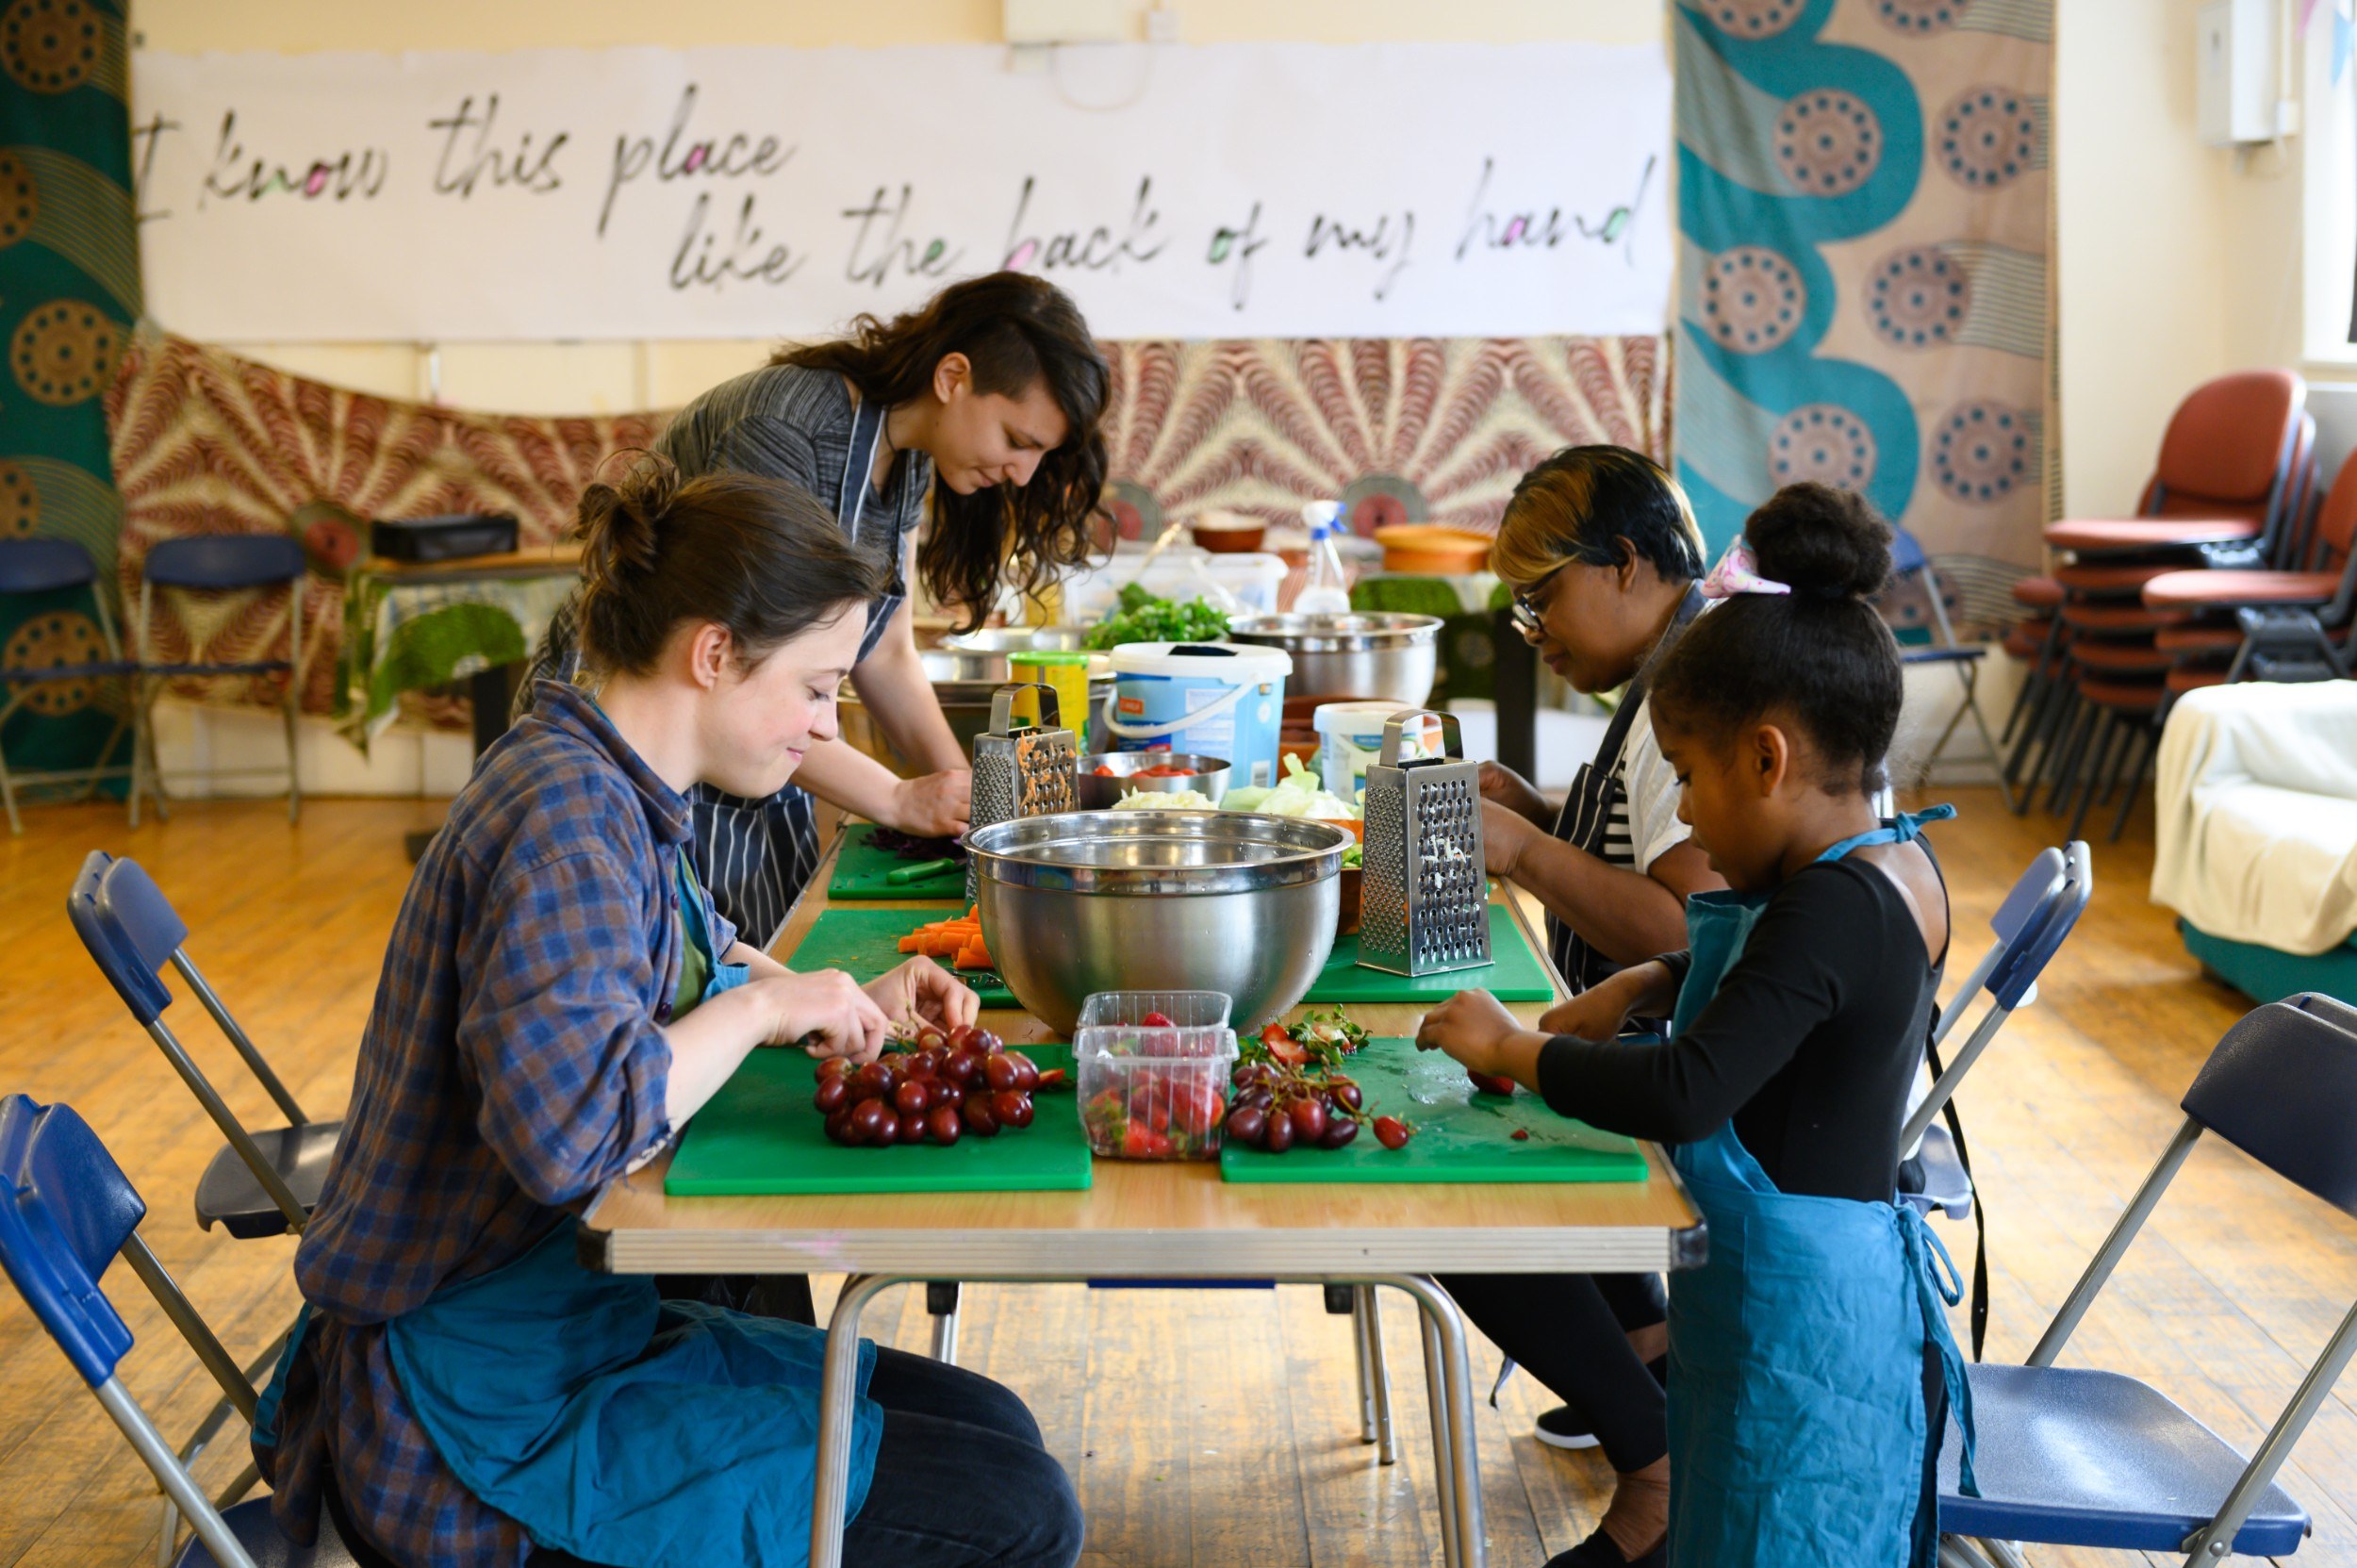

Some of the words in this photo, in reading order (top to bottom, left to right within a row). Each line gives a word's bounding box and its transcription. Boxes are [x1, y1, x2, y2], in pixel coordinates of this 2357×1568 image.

[199, 108, 388, 210] know
[428, 92, 571, 200] this
[596, 83, 799, 239] place
[669, 191, 805, 292] like
[842, 183, 965, 289] the
[1001, 174, 1170, 275] back
[1206, 200, 1270, 310] of
[1305, 209, 1415, 302] my
[1457, 154, 1657, 266] hand
